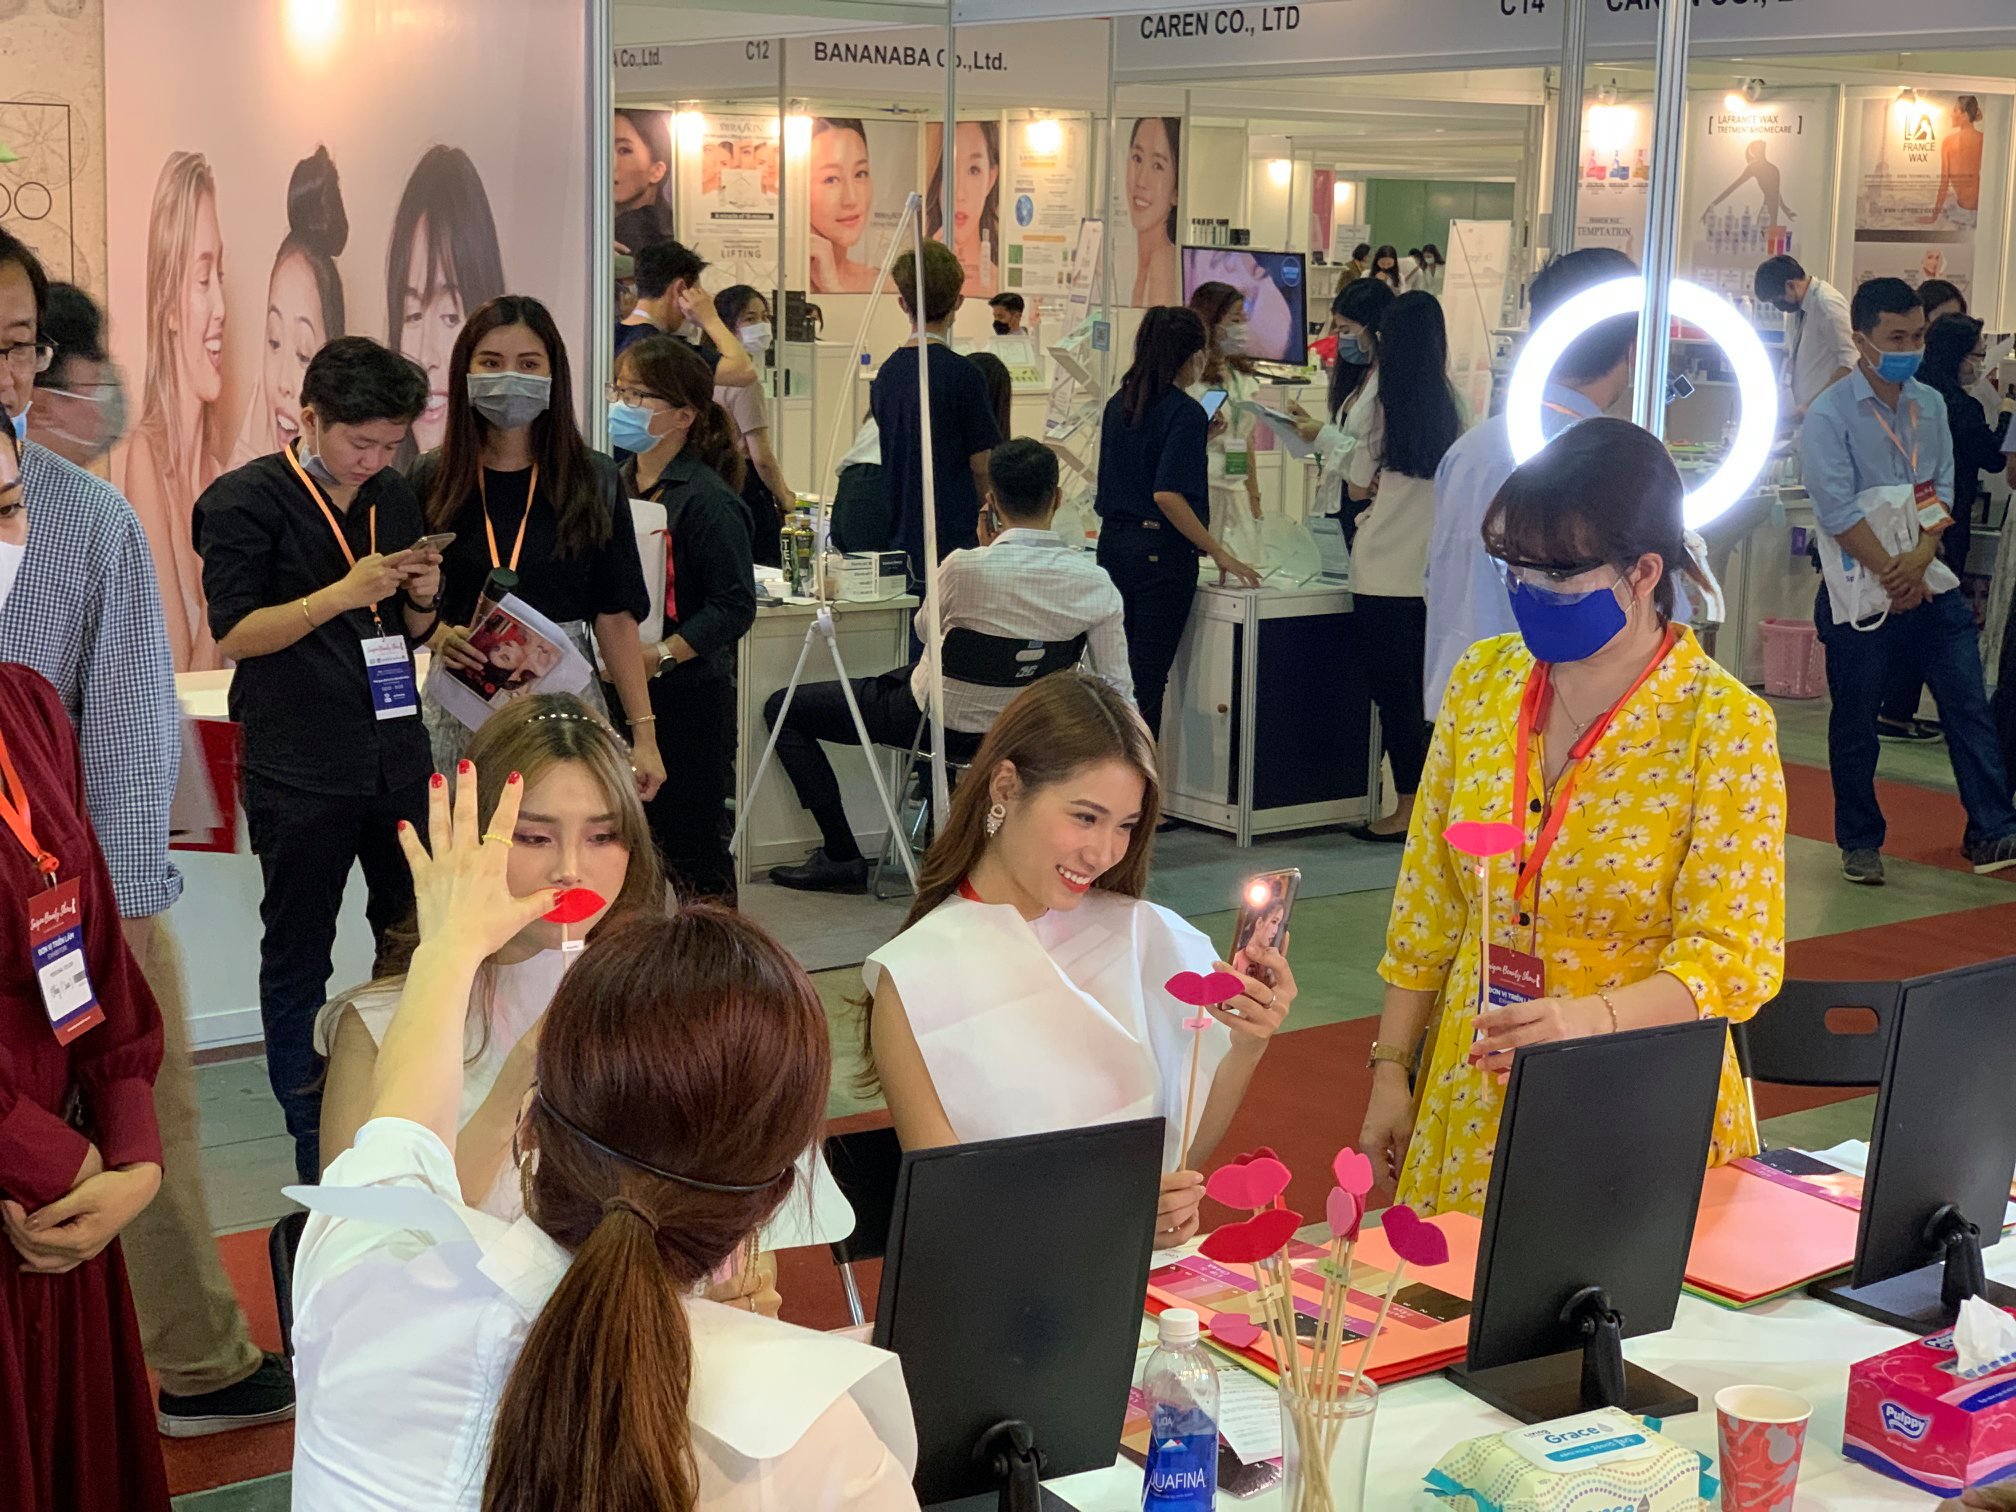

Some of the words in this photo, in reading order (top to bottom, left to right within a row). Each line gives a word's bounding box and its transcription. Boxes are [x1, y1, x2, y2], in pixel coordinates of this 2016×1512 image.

[1140, 12, 1208, 39] CAREN
[1214, 9, 1255, 37] CO.,
[1262, 5, 1300, 32] LTD
[620, 47, 662, 69] Co.,Ltd.
[745, 40, 770, 60] C12
[814, 41, 931, 67] BANANABA
[1759, 115, 1779, 123] WAX
[1903, 142, 1936, 152] FRANCE
[1908, 153, 1928, 162] WAX
[1576, 226, 1631, 237] TEMPTATION
[721, 249, 762, 259] LIFTING
[1885, 1405, 1926, 1435] Pulppy
[1544, 1426, 1600, 1444] Grace
[1151, 1467, 1207, 1492] QUAFINA
